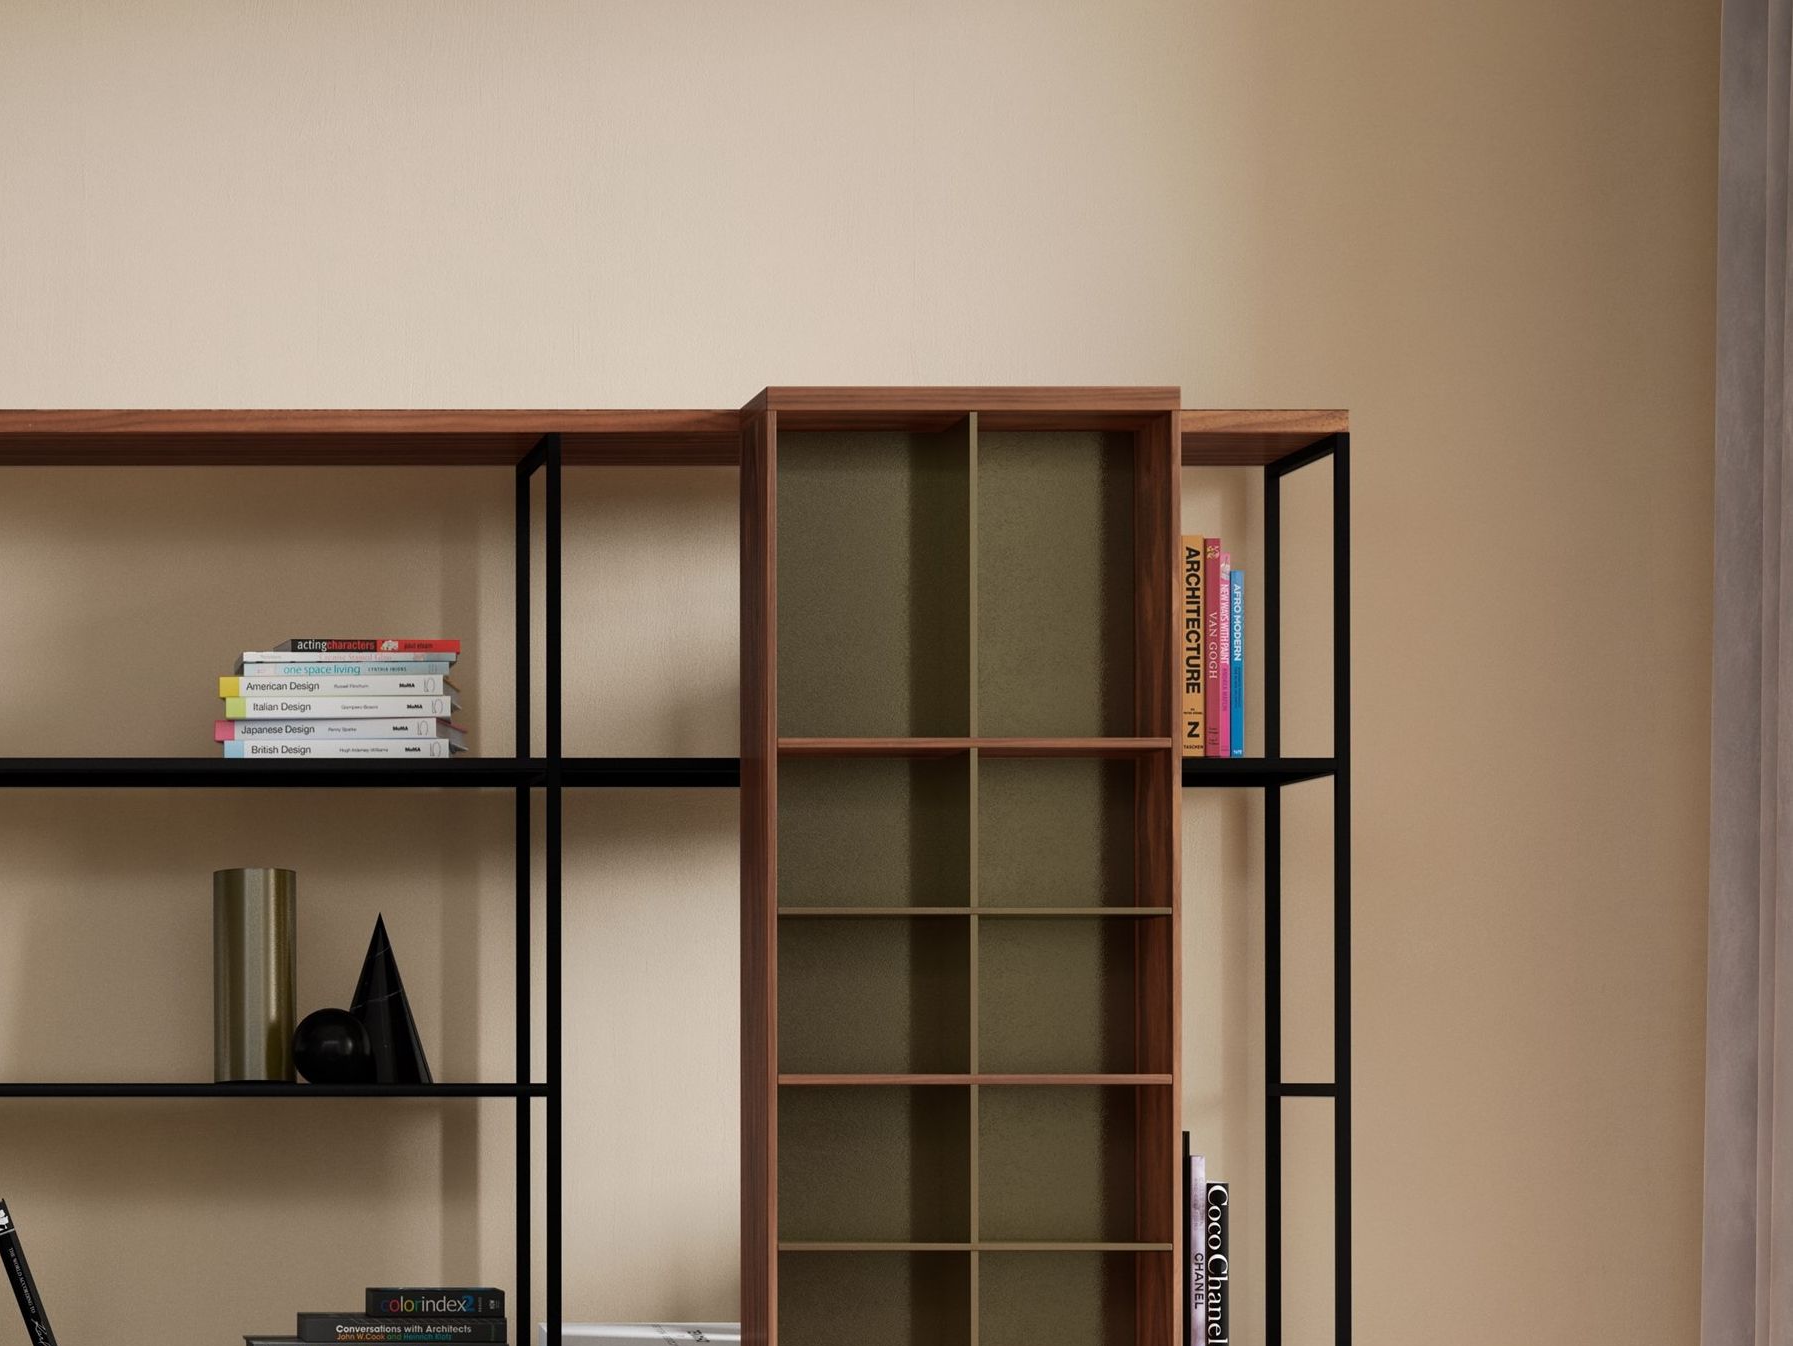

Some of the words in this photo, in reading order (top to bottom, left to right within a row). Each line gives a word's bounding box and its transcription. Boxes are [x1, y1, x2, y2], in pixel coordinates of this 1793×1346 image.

[1220, 584, 1229, 602] NEW
[1233, 584, 1241, 613] AFRO
[1186, 546, 1201, 694] ARCHITECTURE
[1220, 603, 1229, 621] WAYS
[1209, 612, 1217, 637] VAN
[1220, 623, 1229, 642] WITH
[1233, 615, 1241, 661] MODERN
[1209, 641, 1217, 679] GOGH
[1220, 643, 1229, 664] PAINT
[283, 665, 302, 674] one
[304, 665, 331, 676] space
[333, 665, 361, 676] living
[246, 682, 288, 691] American
[290, 682, 320, 691] Design
[253, 703, 279, 712] Italian
[281, 703, 311, 712] Design
[241, 725, 283, 736] Japanese
[285, 725, 315, 735] Design
[251, 746, 279, 755] British
[281, 746, 311, 755] Design
[1207, 1185, 1228, 1251] Coco
[1194, 1253, 1204, 1309] CHANEL
[1207, 1253, 1228, 1345] Chanel
[335, 1324, 402, 1334] Conversations
[403, 1324, 424, 1334] with
[425, 1324, 472, 1334] Architects
